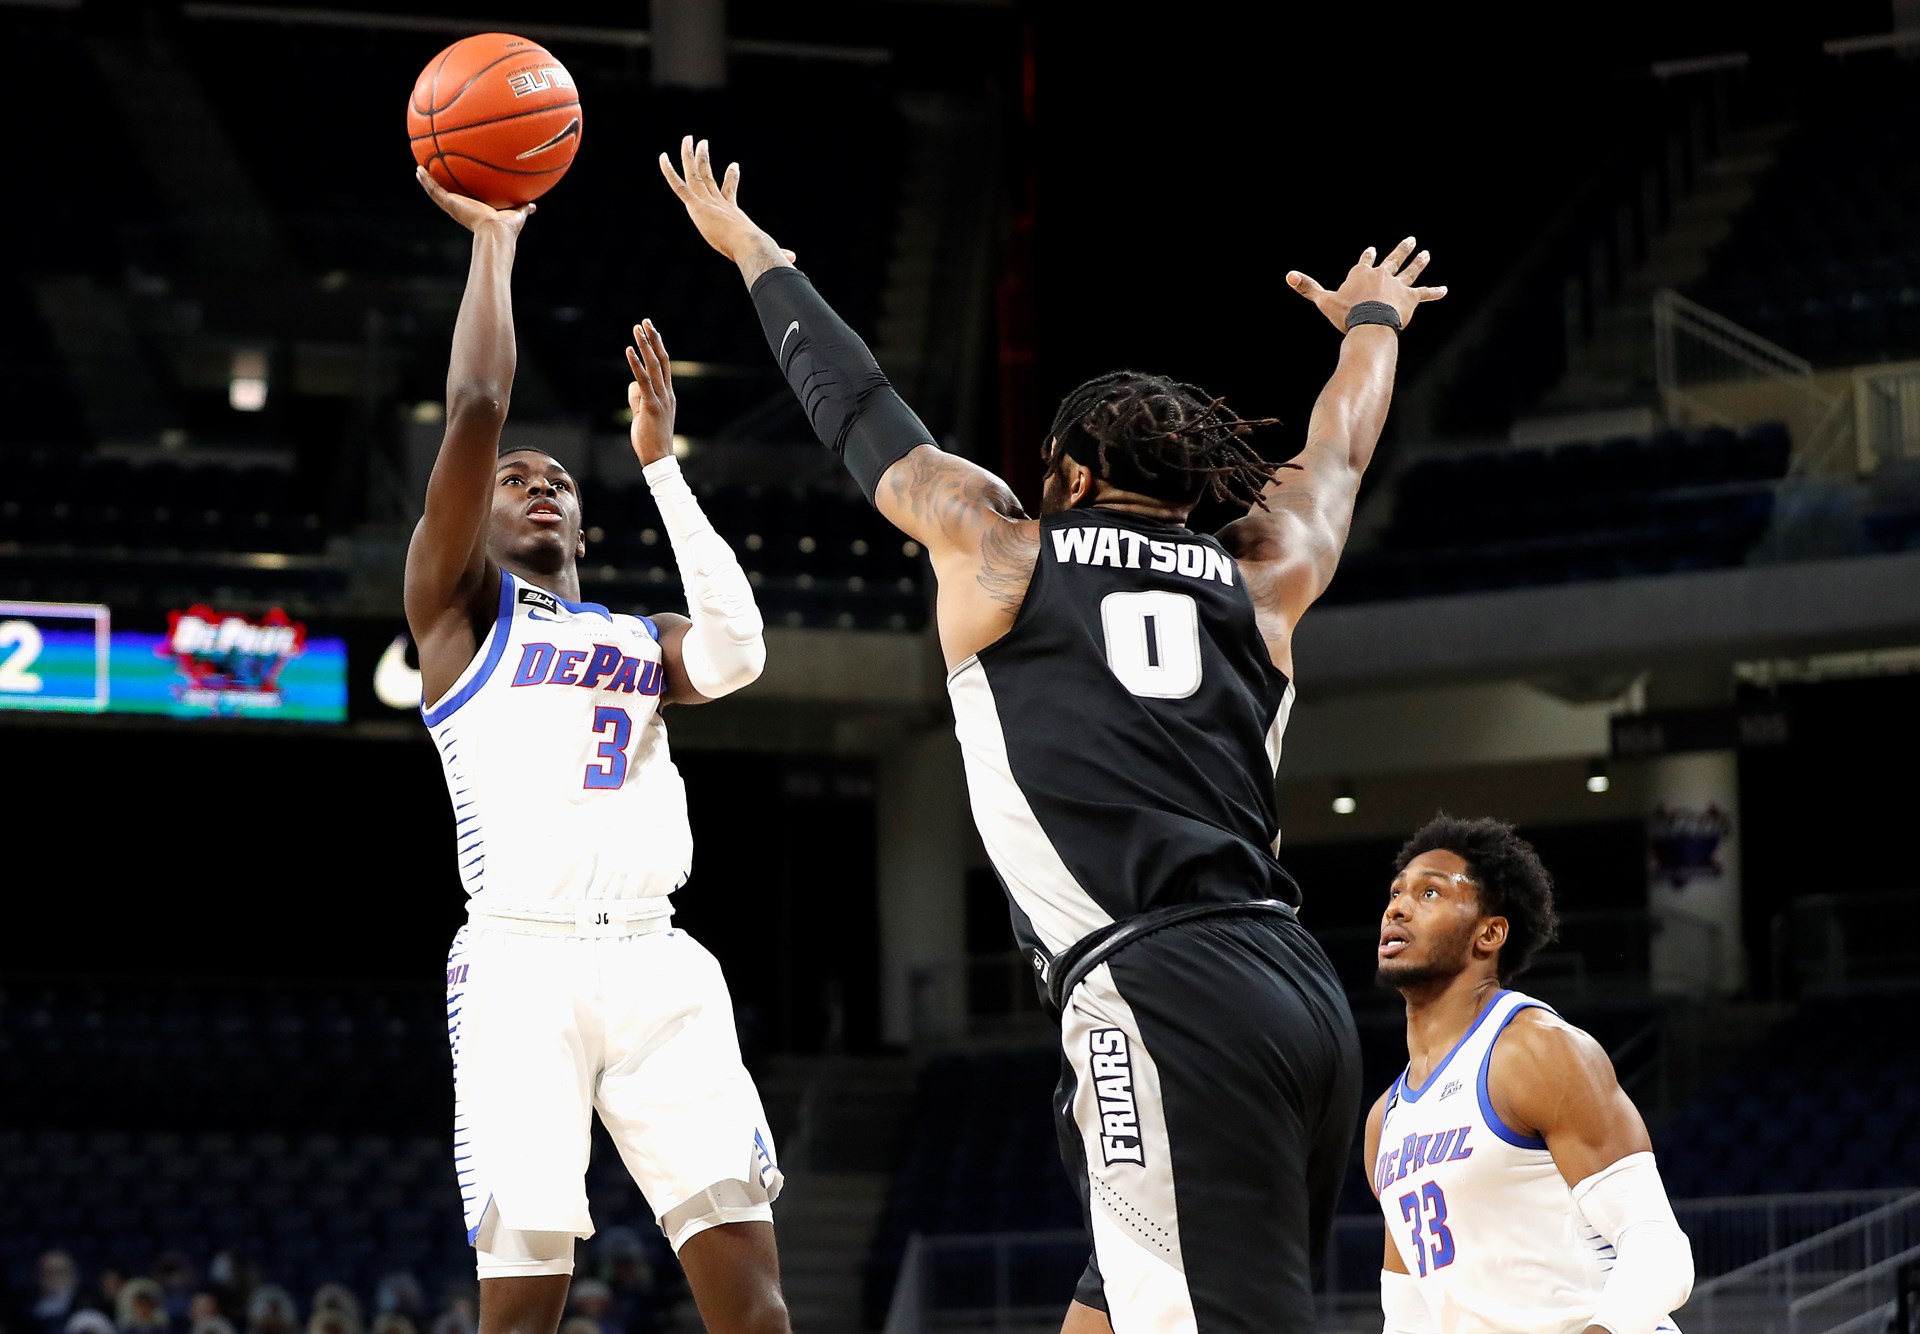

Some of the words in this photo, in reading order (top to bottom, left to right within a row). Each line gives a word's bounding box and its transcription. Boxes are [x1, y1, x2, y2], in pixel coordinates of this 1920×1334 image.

[1050, 526, 1234, 587] WATSON
[524, 591, 555, 609] BLM
[510, 642, 663, 697] DEPAU
[1100, 589, 1204, 700] 0
[582, 705, 633, 790] 3
[1090, 1028, 1145, 1168] FRIARS
[1398, 1180, 1456, 1278] 33
